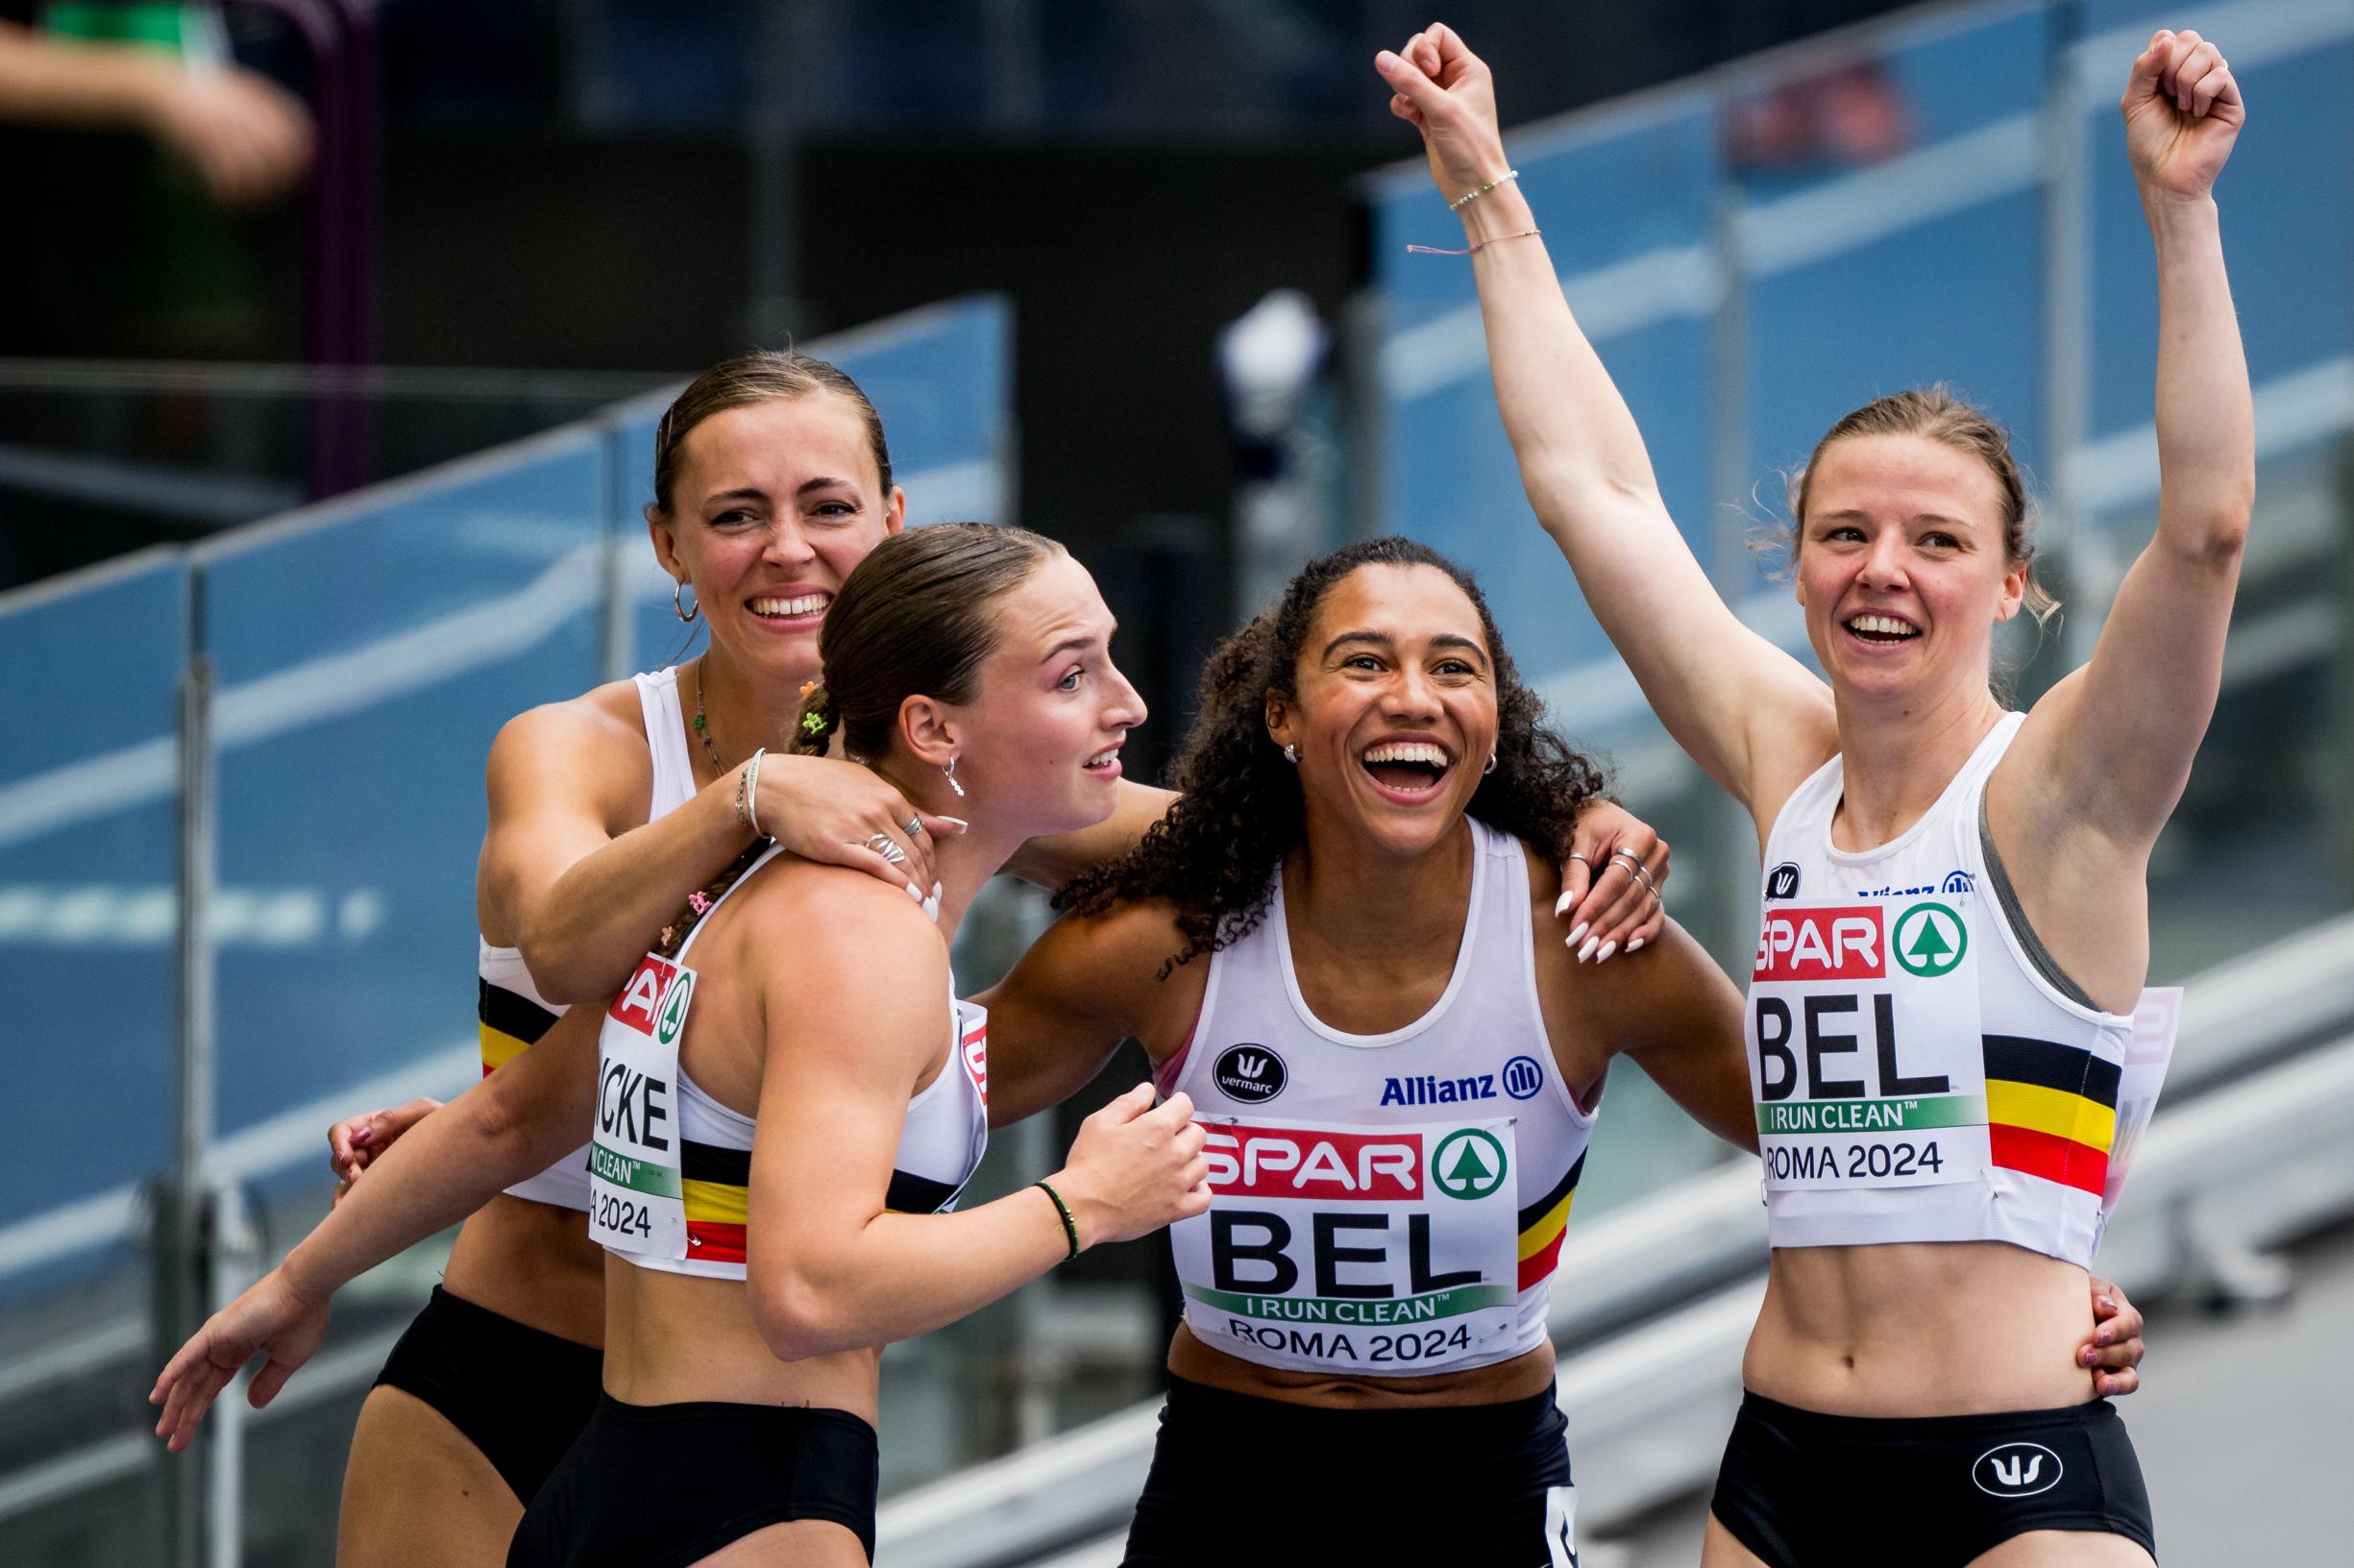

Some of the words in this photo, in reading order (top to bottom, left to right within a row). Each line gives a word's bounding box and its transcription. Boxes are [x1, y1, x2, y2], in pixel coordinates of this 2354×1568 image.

[1755, 917, 1879, 971] SPAR
[1756, 993, 1949, 1101] BEL
[1221, 1075, 1273, 1093] vermarc
[1380, 1074, 1497, 1106] Allianz
[1770, 1108, 1775, 1130] I
[1777, 1106, 1817, 1130] RUN
[1203, 1132, 1417, 1191] SPAR
[1767, 1145, 1840, 1180] ROMA
[1848, 1141, 1944, 1178] 2024
[599, 1193, 651, 1238] 2024
[1210, 1210, 1483, 1298] BEL
[1246, 1298, 1253, 1314] I
[1262, 1298, 1327, 1320] RUN
[1228, 1318, 1359, 1360] ROMA
[1369, 1324, 1472, 1362] 2024
